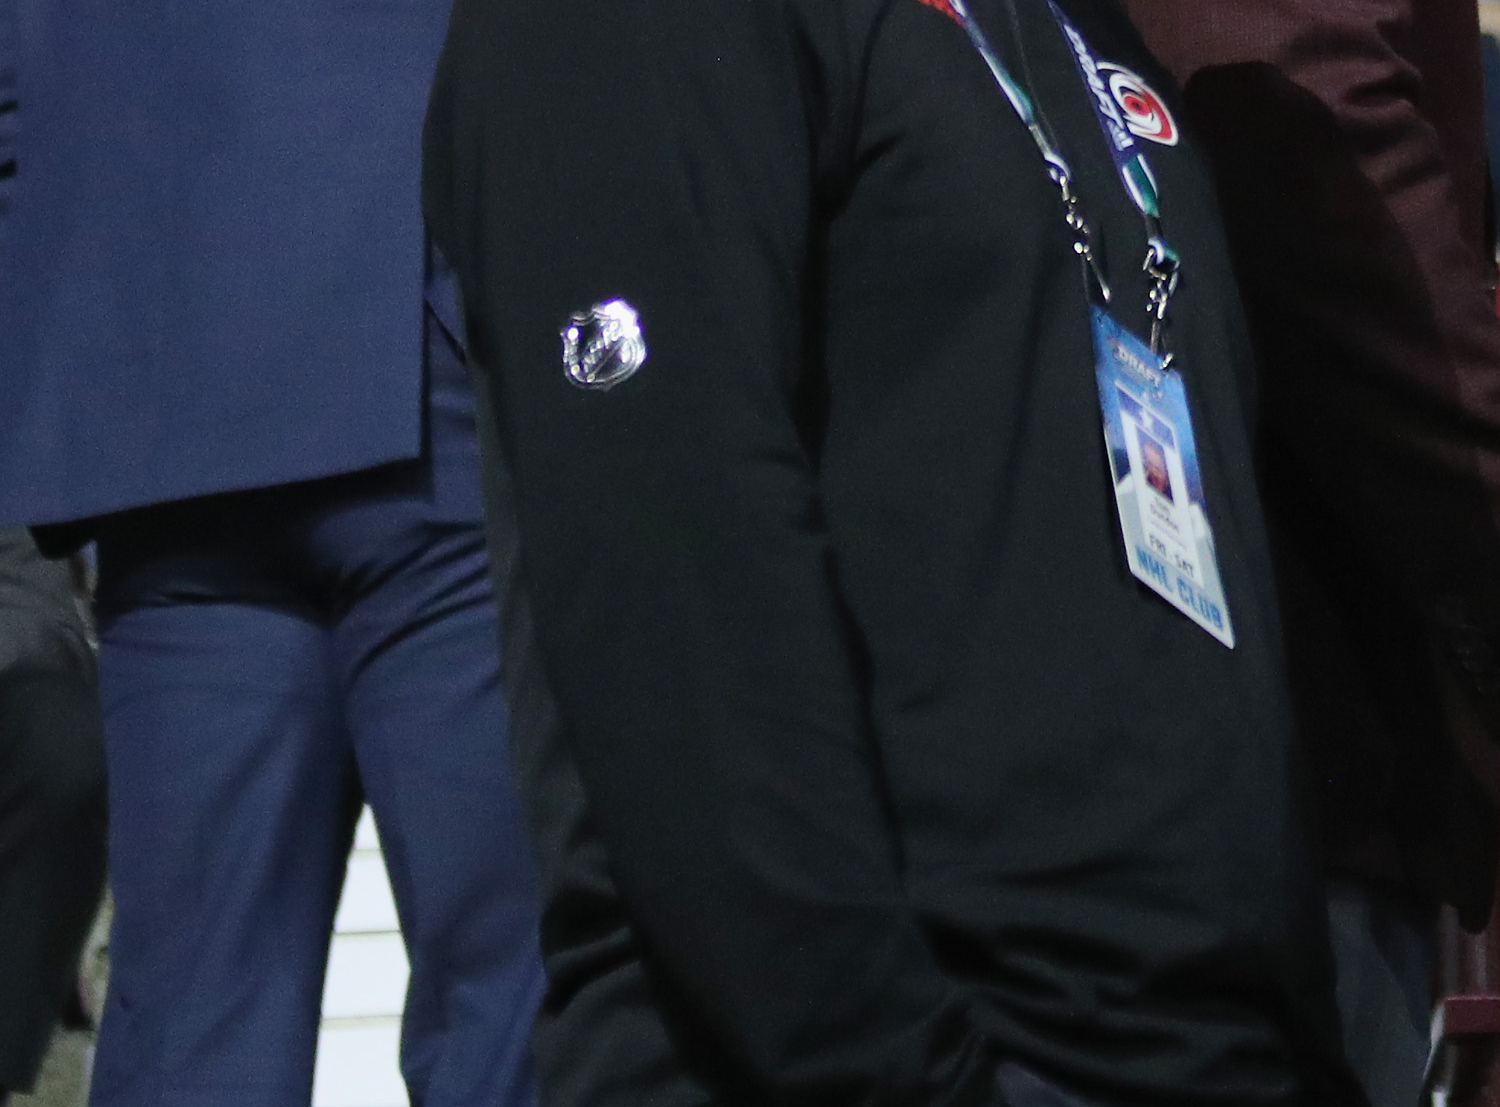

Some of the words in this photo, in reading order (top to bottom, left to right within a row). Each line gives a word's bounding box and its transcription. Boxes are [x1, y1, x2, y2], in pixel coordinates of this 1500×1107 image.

[1063, 24, 1125, 130] DRAFT
[1149, 533, 1167, 556] FRI
[1175, 553, 1195, 579] SAT
[1177, 576, 1224, 631] CLUB
